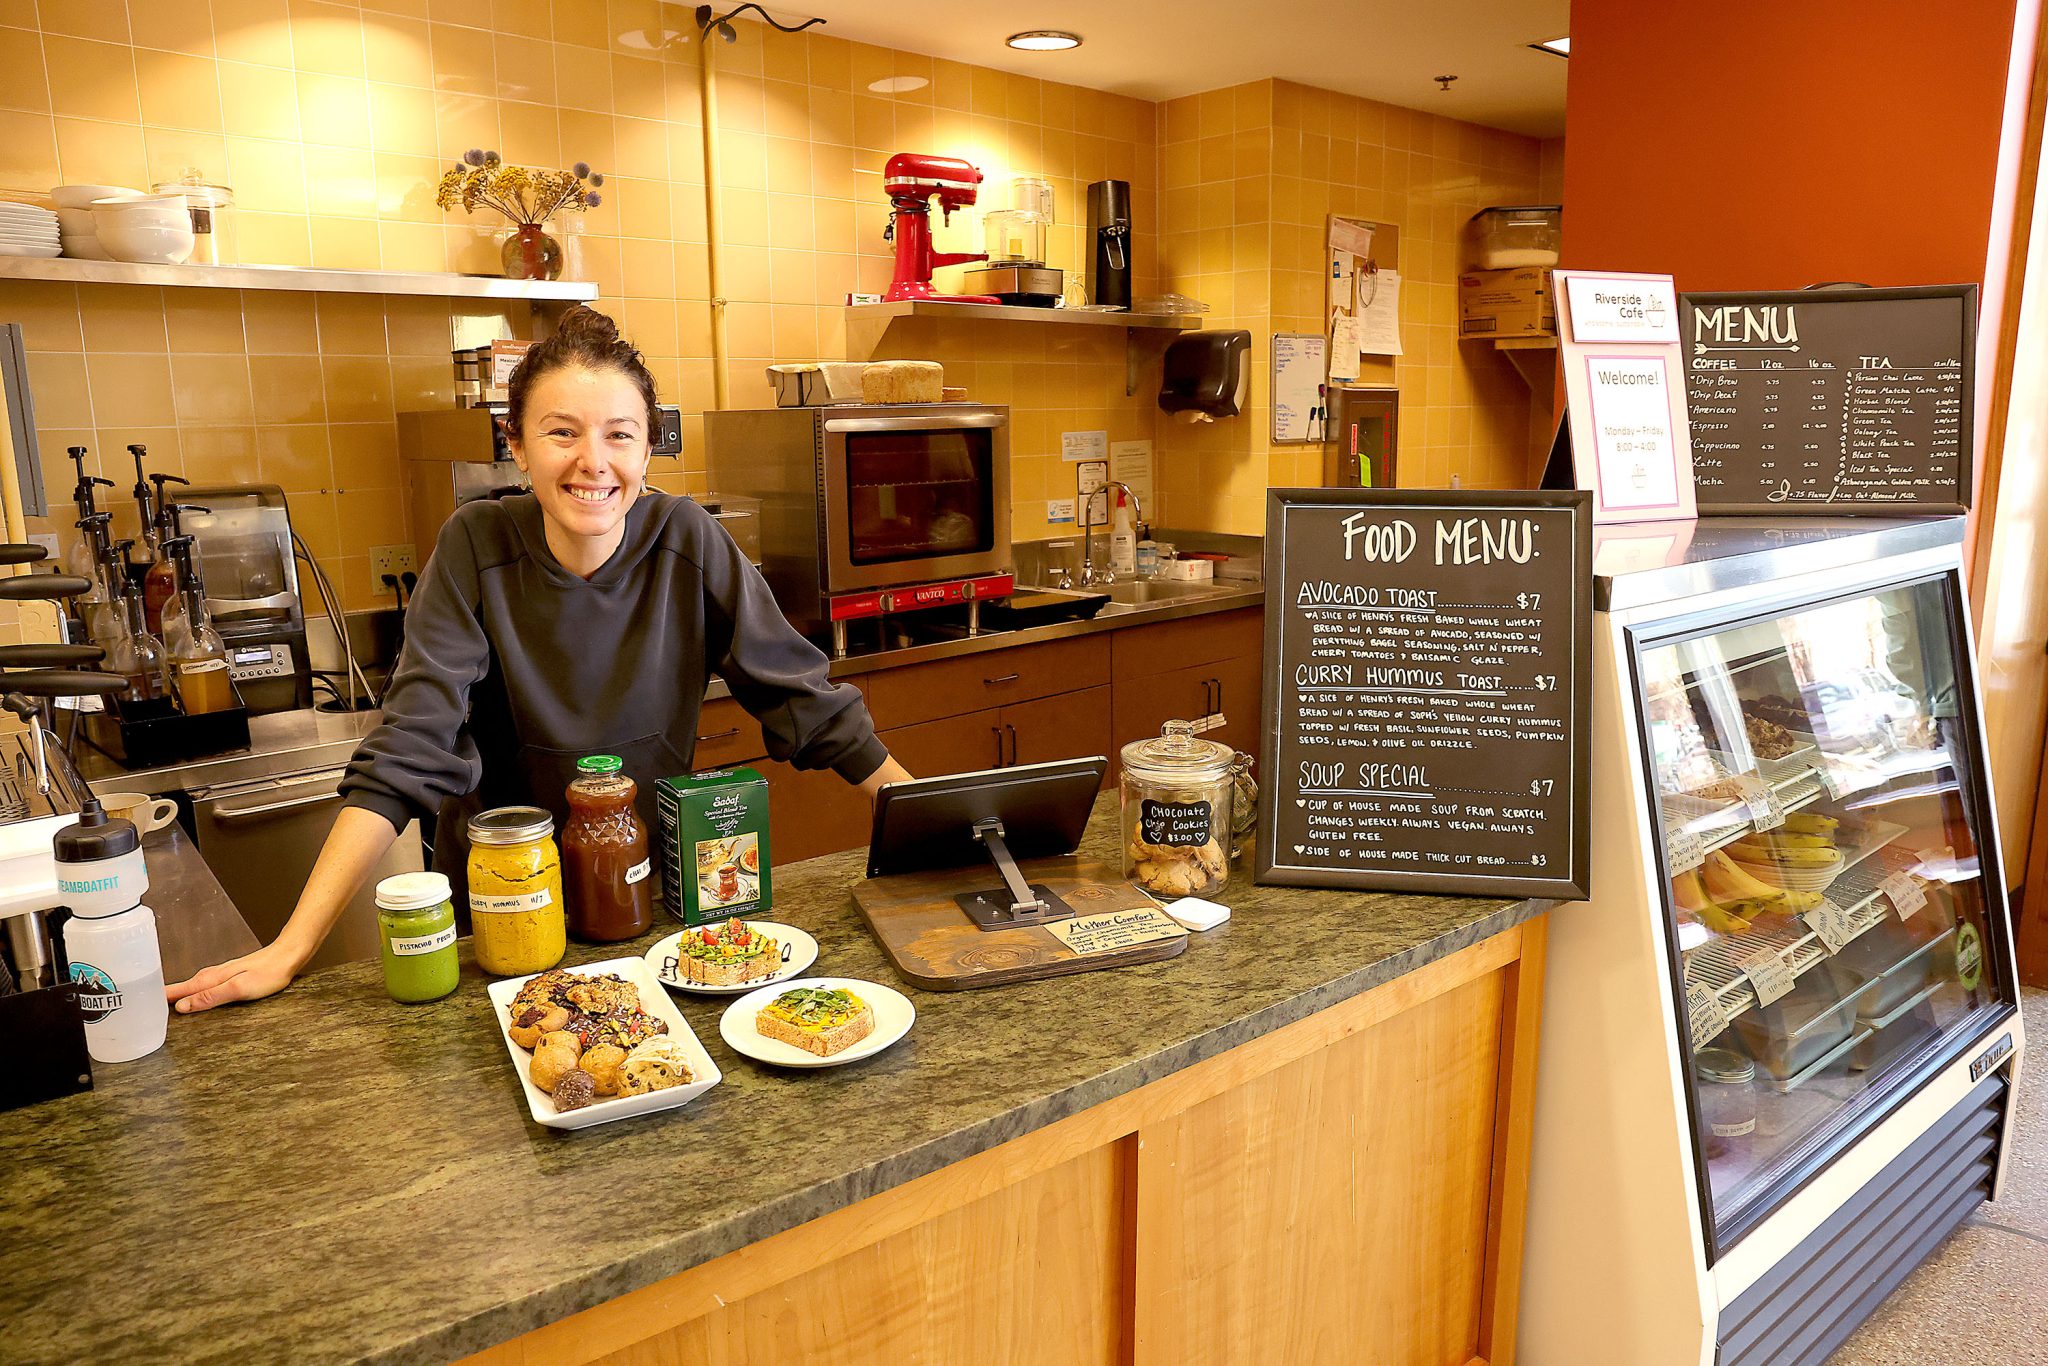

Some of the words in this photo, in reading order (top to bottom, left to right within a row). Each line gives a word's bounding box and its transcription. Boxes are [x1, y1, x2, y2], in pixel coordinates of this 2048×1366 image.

[1595, 293, 1642, 305] Riverside
[1619, 307, 1644, 318] Cafe
[1694, 306, 1799, 344] MENU
[1692, 358, 1738, 369] COFFEE
[1859, 356, 1893, 369] TEA
[1598, 370, 1660, 386] Welcome!
[1696, 375, 1714, 387] Drip
[1717, 375, 1738, 386] Brew
[1694, 389, 1711, 401] Drip
[1714, 390, 1738, 399] Decaf
[1855, 385, 1877, 395] Green
[1880, 386, 1911, 394] Matcha
[1915, 386, 1939, 394] Latte
[1885, 397, 1911, 405] Blend
[1692, 404, 1737, 414] Americano
[1692, 420, 1729, 432] Espresso
[1853, 416, 1875, 425] Green
[1604, 426, 1635, 437] Monday
[1642, 426, 1664, 437] Friday
[1616, 442, 1633, 452] 8:00
[1640, 442, 1657, 451] 4:00
[1852, 451, 1873, 459] Black
[1877, 451, 1890, 459] Tea
[1693, 456, 1723, 468] Latte
[1850, 464, 1866, 473] Iced
[1869, 465, 1880, 473] Tea
[1884, 464, 1914, 475] Special
[1693, 475, 1725, 486] Mocha
[1913, 478, 1931, 486] Milk
[1807, 490, 1829, 499] Flavor
[1341, 511, 1417, 564] FOOD
[1434, 517, 1541, 566] MENU:
[1297, 580, 1379, 606] AVOCADO
[1385, 588, 1438, 609] TOAST
[1312, 611, 1319, 620] A
[1347, 612, 1357, 620] OF
[1361, 611, 1395, 622] HENRY'S
[1400, 614, 1430, 623] FRESH
[1435, 615, 1465, 625] BAKED
[1468, 618, 1500, 626] WHOLE
[1505, 619, 1542, 627] WHEAT
[1313, 624, 1344, 634] BREAD
[1366, 626, 1373, 635] A
[1378, 626, 1410, 636] SPREAD
[1415, 629, 1426, 637] OF
[1430, 629, 1472, 640] AVOCADO,
[1475, 631, 1525, 640] SEASONED
[1312, 637, 1365, 648] EVERYTHING
[1370, 638, 1398, 648] BAGEL
[1463, 643, 1485, 652] SALT
[1501, 645, 1543, 657] PEPPER,
[1311, 649, 1346, 657] CHERRY
[1351, 650, 1395, 660] TOMATOES
[1295, 663, 1352, 686] CURRY
[1366, 666, 1444, 686] HUMMUS
[1456, 673, 1502, 689] TOAST
[1345, 694, 1354, 702] OF
[1360, 694, 1393, 704] HENRY'S
[1397, 696, 1425, 705] FRESH
[1429, 697, 1459, 707] BAKED
[1465, 701, 1496, 709] WHOLE
[1501, 703, 1536, 712] WHEAT
[1299, 708, 1328, 718] BREAD
[1347, 709, 1354, 717] A
[1357, 709, 1390, 718] SPREAD
[1394, 711, 1403, 719] OF
[1479, 716, 1511, 725] CURRY
[1517, 718, 1562, 728] HUMMUS
[1298, 722, 1334, 732] TOPPED
[1354, 724, 1380, 733] FRESH
[1476, 728, 1512, 739] SEEDS,
[1515, 730, 1565, 741] PUMPKIN
[1298, 760, 1345, 789] SOUP
[1359, 763, 1431, 788] SPECIAL
[1529, 779, 1554, 797] $7
[1308, 799, 1327, 810] CUP
[1333, 801, 1344, 810] OF
[1349, 801, 1381, 811] HOUSE
[1389, 804, 1422, 813] MADE
[1431, 804, 1458, 815] SOUP
[1465, 806, 1495, 817] FROM
[1502, 808, 1547, 821] SCRATCH.
[1173, 820, 1209, 830] Cookies
[1308, 815, 1354, 827] CHANGES
[1358, 817, 1399, 827] WEEKLY.
[1448, 820, 1488, 831] VEGAN.
[1353, 832, 1384, 841] FREE.
[1306, 846, 1330, 856] SIDE
[1339, 849, 1352, 858] OF
[1359, 850, 1387, 859] HOUSE
[1391, 851, 1419, 860] MADE
[1425, 852, 1450, 862] THICK
[1454, 855, 1472, 864] CUT
[1477, 855, 1506, 865] BREAD
[1530, 853, 1547, 866] $3
[1069, 921, 1112, 934] Mother
[1113, 911, 1156, 924] Comfort
[399, 939, 432, 950] PISTACHIO
[81, 996, 104, 1009] BOAT
[106, 994, 123, 1008] FIT
